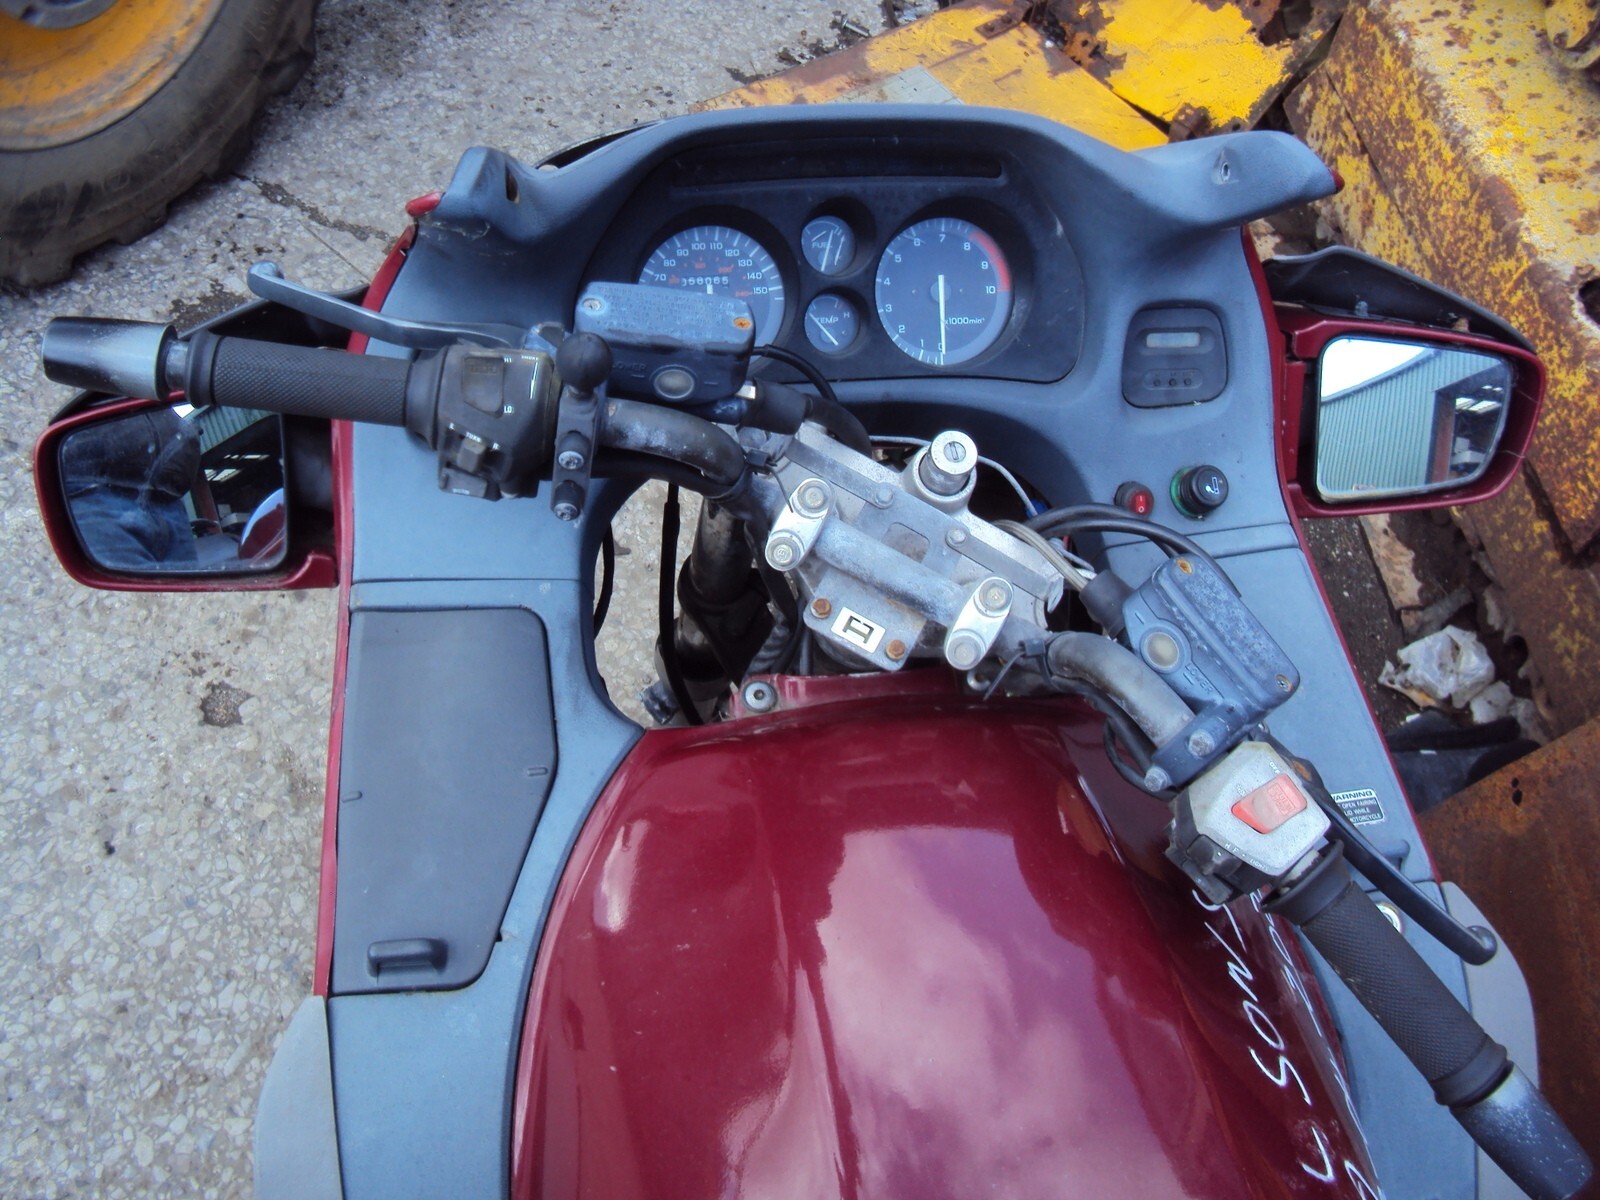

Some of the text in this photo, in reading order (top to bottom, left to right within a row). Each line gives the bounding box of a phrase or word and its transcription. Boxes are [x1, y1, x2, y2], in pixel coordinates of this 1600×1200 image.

[913, 237, 921, 246] 6
[938, 234, 946, 243] 7
[691, 242, 706, 251] 100
[709, 242, 723, 250] 110
[963, 242, 971, 251] 8
[725, 249, 740, 257] 120
[663, 259, 676, 267] 80
[738, 259, 753, 267] 130
[894, 254, 902, 263] 5
[981, 261, 989, 270] 9
[654, 273, 667, 282] 70
[746, 272, 763, 280] 140
[883, 277, 891, 286] 4
[753, 287, 768, 295] 150
[985, 285, 996, 294] 10
[885, 304, 893, 312] 3
[898, 324, 906, 333] 2
[612, 360, 647, 370] OWER
